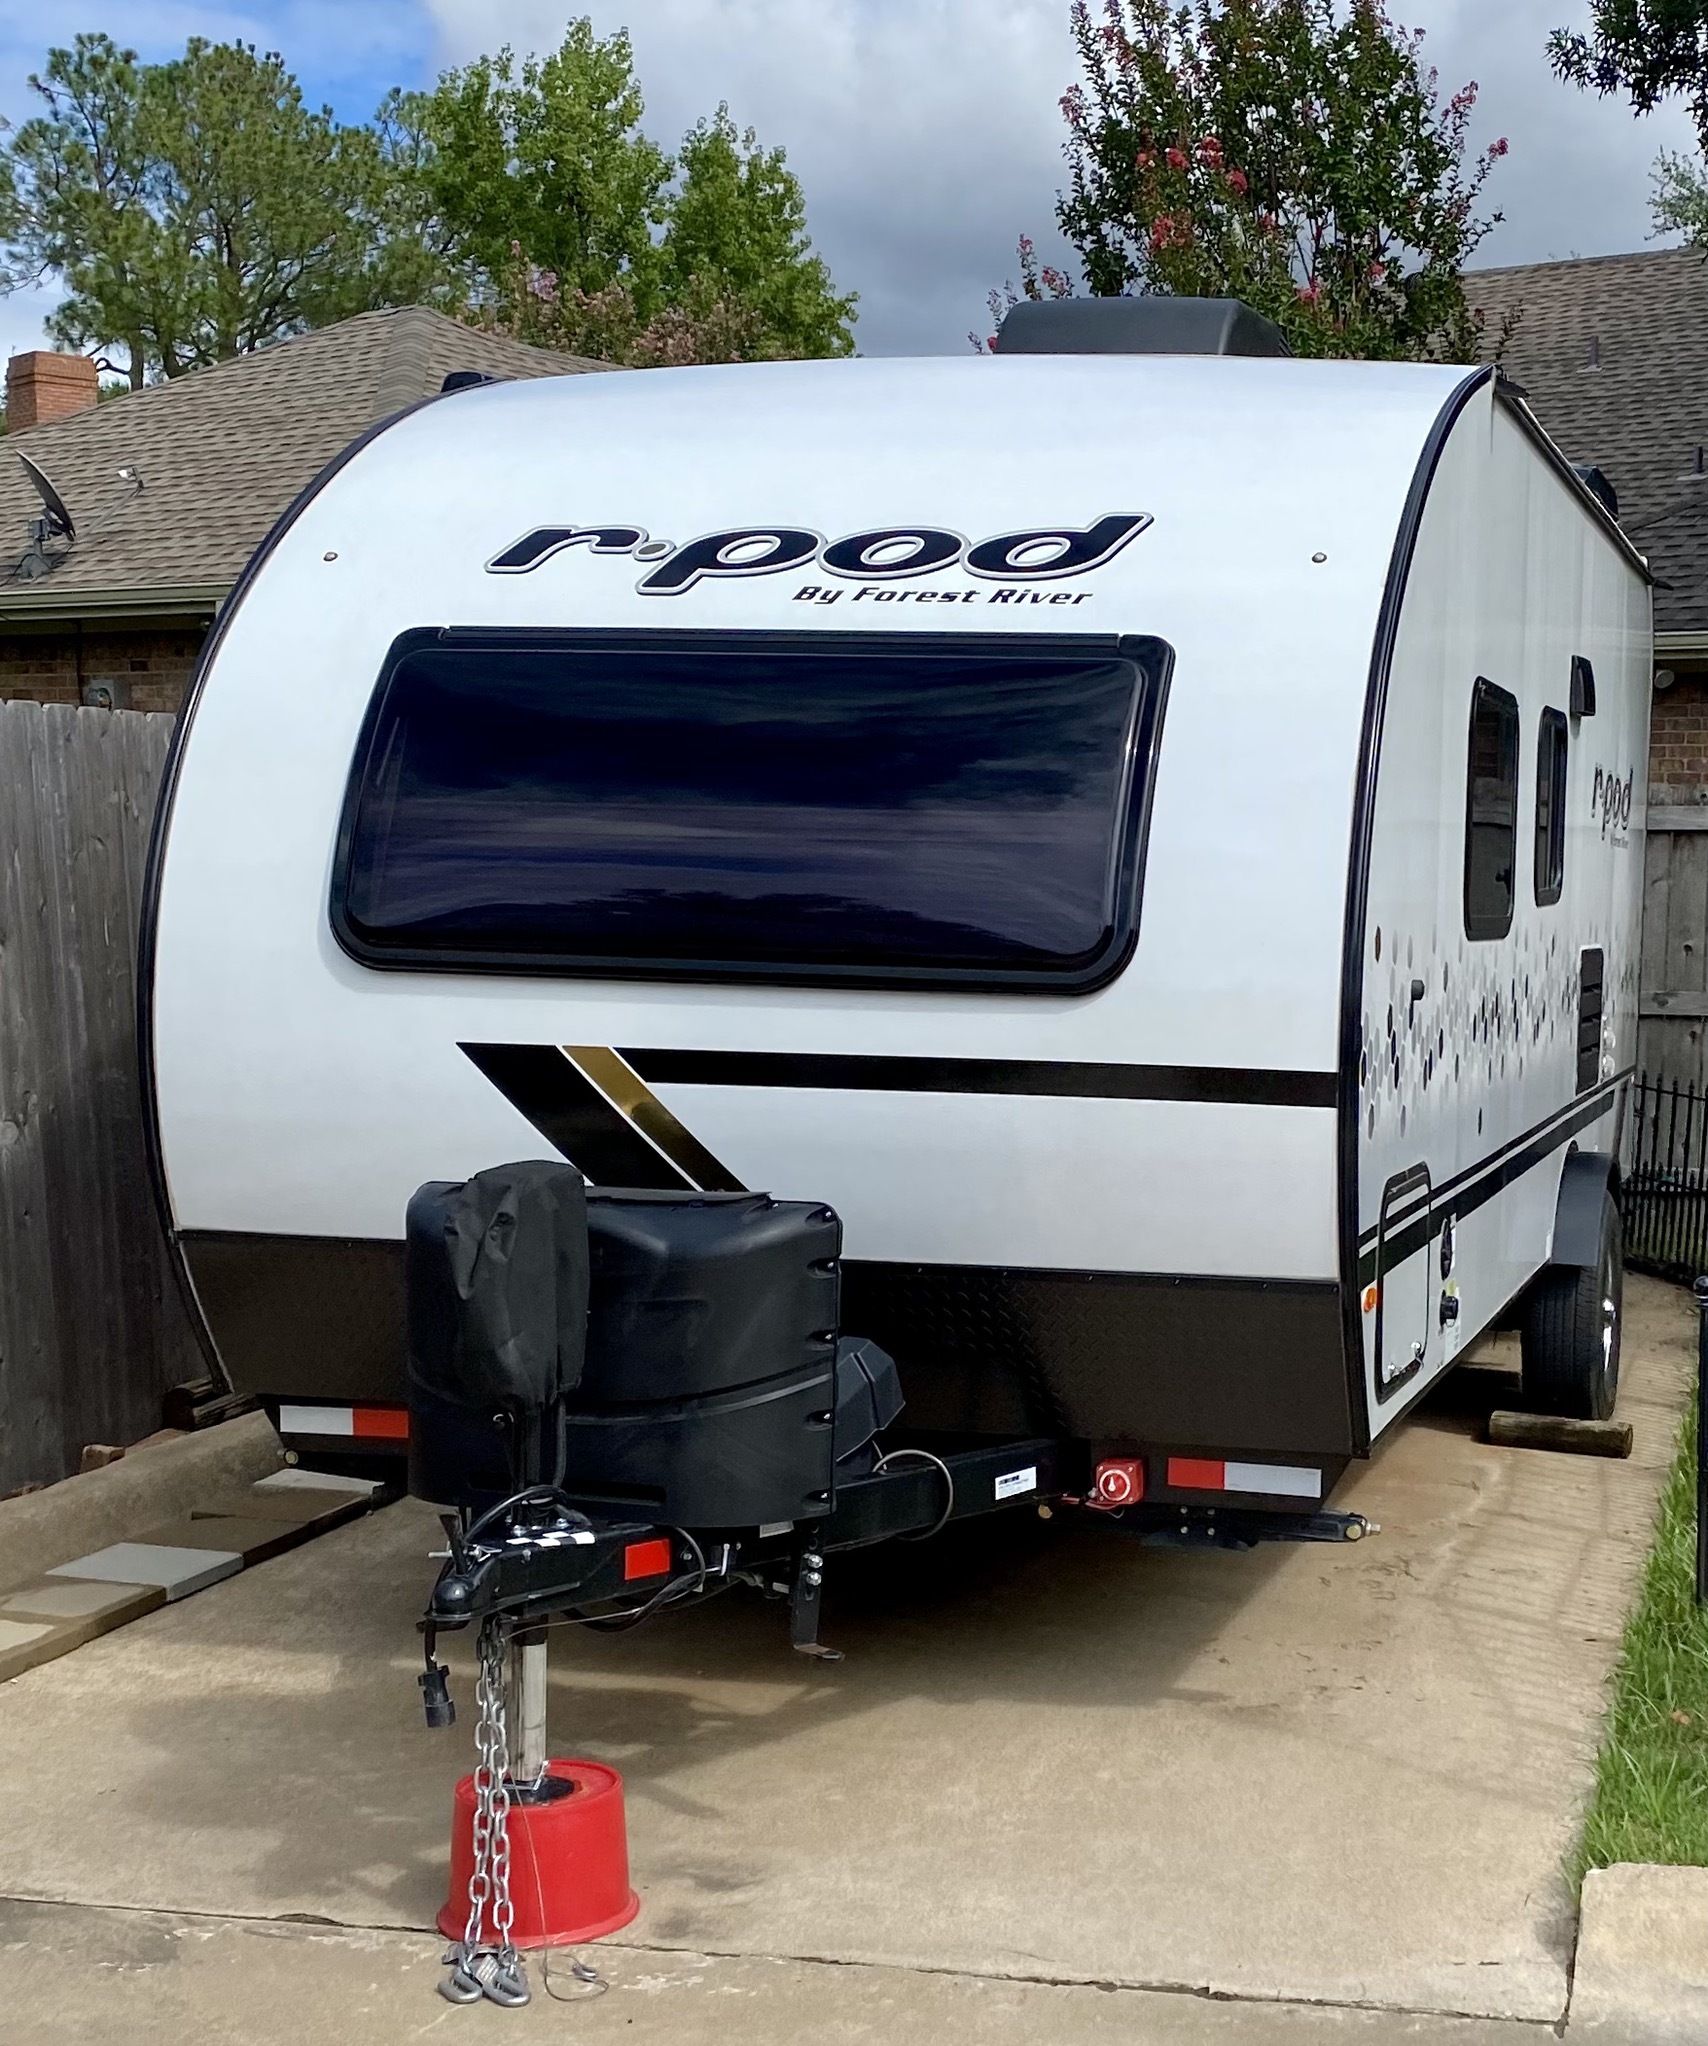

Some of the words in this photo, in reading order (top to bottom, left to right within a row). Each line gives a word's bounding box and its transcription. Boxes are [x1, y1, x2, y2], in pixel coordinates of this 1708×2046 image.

[791, 586, 844, 605] By
[852, 587, 980, 603] Forest
[988, 588, 1094, 605] River
